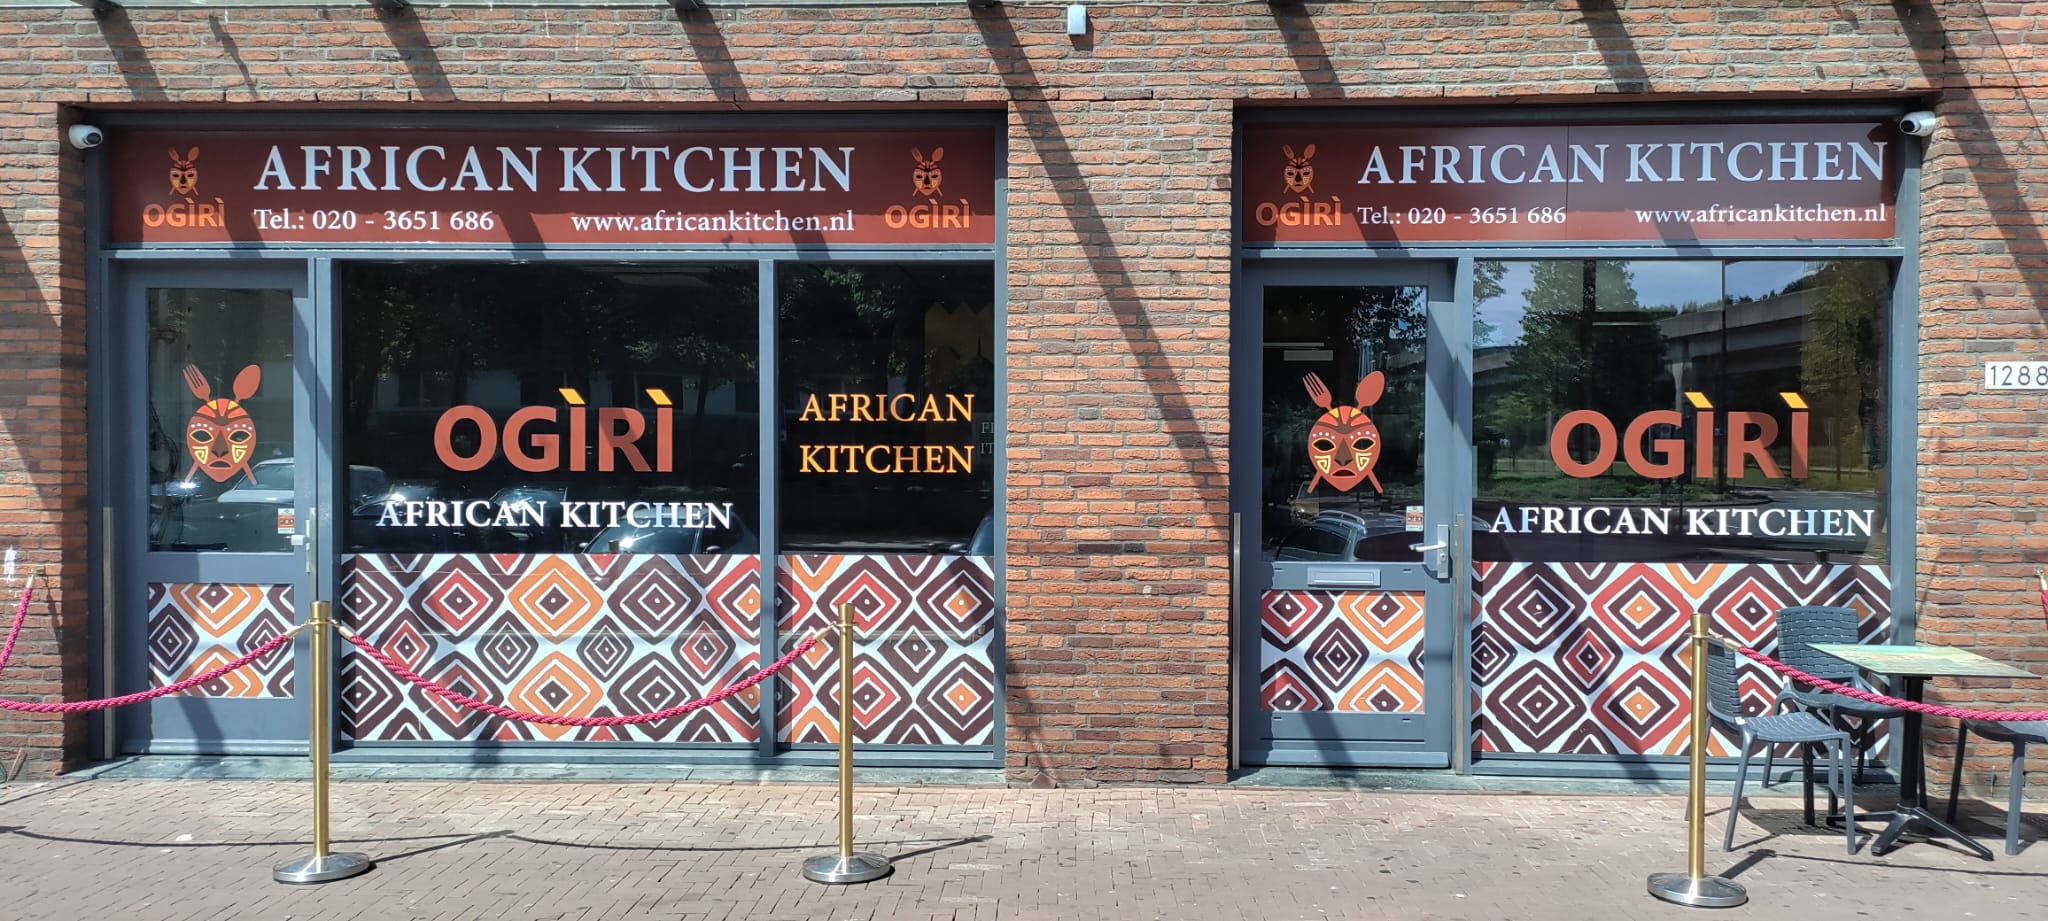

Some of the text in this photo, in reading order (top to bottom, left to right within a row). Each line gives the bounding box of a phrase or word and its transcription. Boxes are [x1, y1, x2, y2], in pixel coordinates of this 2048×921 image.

[253, 144, 856, 193] AFRICAN KITCHEN
[1357, 141, 1888, 184] AFRICAN KITCHEN
[253, 208, 305, 230] Tel.:
[312, 210, 357, 231] 020
[383, 210, 441, 231] 3651
[449, 210, 494, 231] 686
[570, 209, 855, 232] www.africankitchen.nl
[1357, 206, 1401, 226] Tel.:
[1407, 207, 1446, 225] 020
[1469, 206, 1518, 225] 3651
[1527, 206, 1567, 225] 686
[1635, 204, 1887, 223] www.africankitchen.nl
[798, 393, 975, 422] AFRICAN
[799, 444, 975, 474] KITCHEN
[376, 500, 733, 529] AFRICAN KITCHEN
[1488, 506, 1875, 537] AFRICAN KITCHEN
